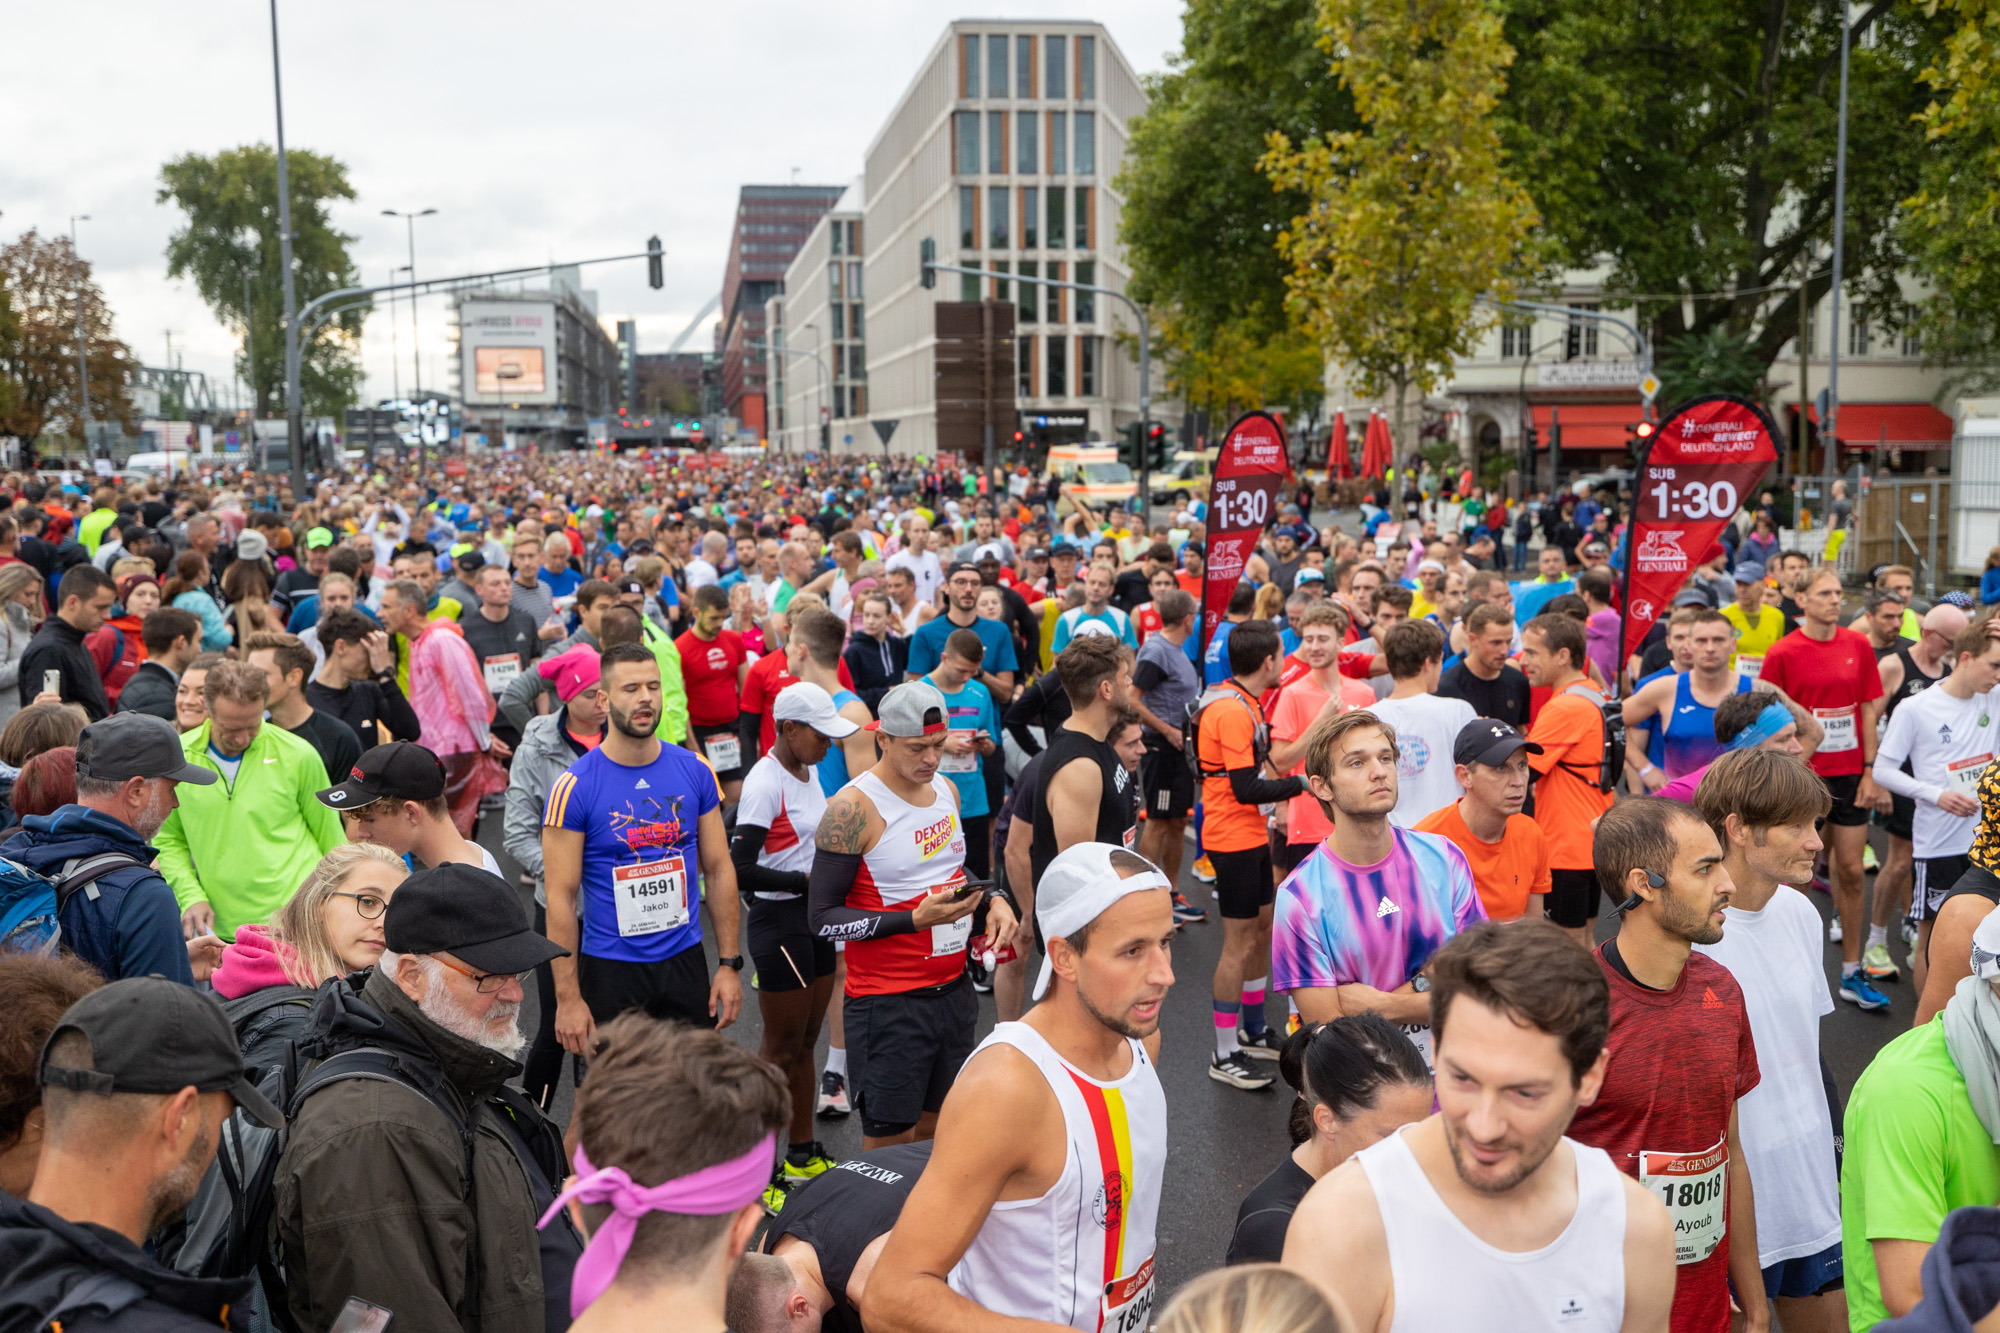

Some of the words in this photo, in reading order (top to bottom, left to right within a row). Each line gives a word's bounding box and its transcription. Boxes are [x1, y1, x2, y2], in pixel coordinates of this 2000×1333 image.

[1713, 430, 1759, 443] BEWEGT
[1253, 445, 1280, 455] BEWEGT
[1680, 441, 1755, 453] DEUTSCHLAND
[1233, 456, 1277, 466] DEUTSCHLAND
[1649, 467, 1676, 480] SUB
[1216, 480, 1236, 492] SUB
[1650, 481, 1737, 519] 1:30
[1213, 488, 1268, 529] 1:30
[1637, 560, 1688, 572] GENERALI
[626, 825, 651, 838] BMW
[664, 821, 680, 833] 20
[914, 815, 950, 845] DEXTRO
[665, 832, 680, 843] 21
[923, 822, 953, 857] ENERGY
[950, 840, 963, 849] SPORT
[638, 862, 674, 876] GENERALI
[627, 877, 675, 899] 14591
[641, 901, 669, 913] Jakob
[1376, 905, 1400, 918] adidas
[818, 917, 869, 937] DEXTRO
[952, 921, 967, 931] René
[827, 926, 869, 942] ENERGY
[1701, 1000, 1724, 1009] adidas
[1686, 1149, 1722, 1172] GENERALI
[1662, 1172, 1721, 1207] 18018
[1674, 1213, 1712, 1234] Ayoub
[1676, 1252, 1697, 1261] RATHON
